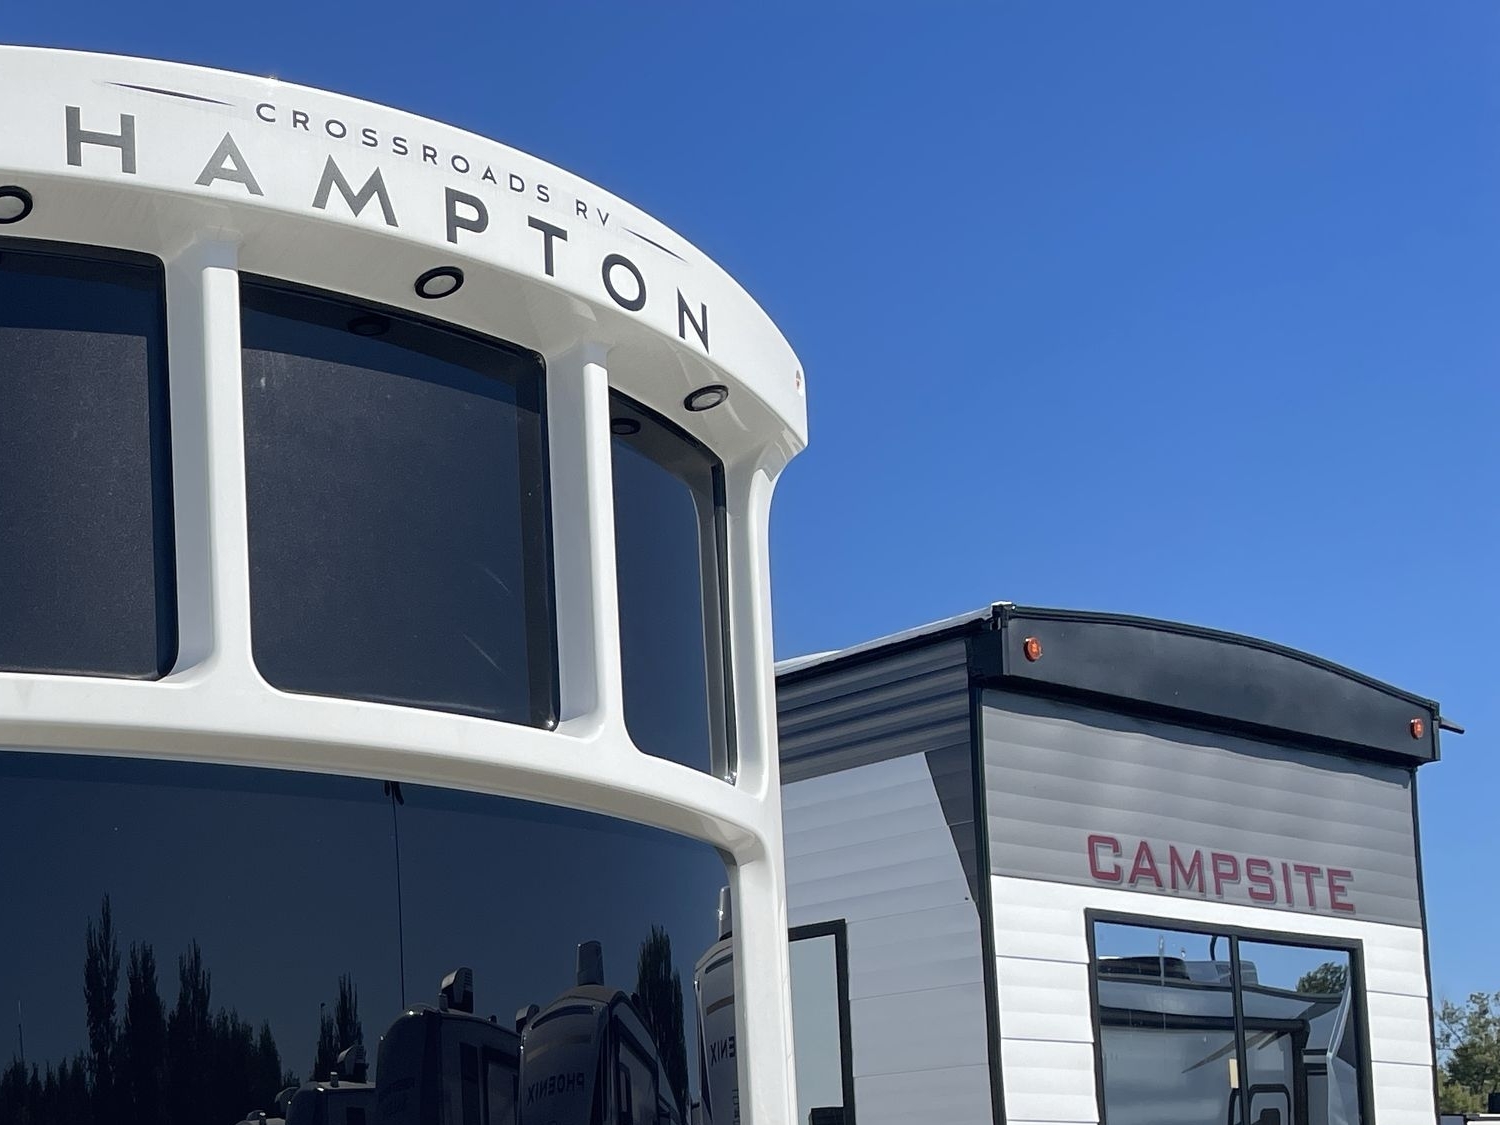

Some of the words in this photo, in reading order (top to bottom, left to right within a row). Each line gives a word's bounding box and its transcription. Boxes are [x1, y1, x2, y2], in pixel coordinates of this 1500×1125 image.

[256, 102, 551, 204] CROSSROADS
[575, 198, 610, 226] RV
[65, 105, 711, 354] HAMPTON
[1087, 833, 1356, 914] CAMPSITE
